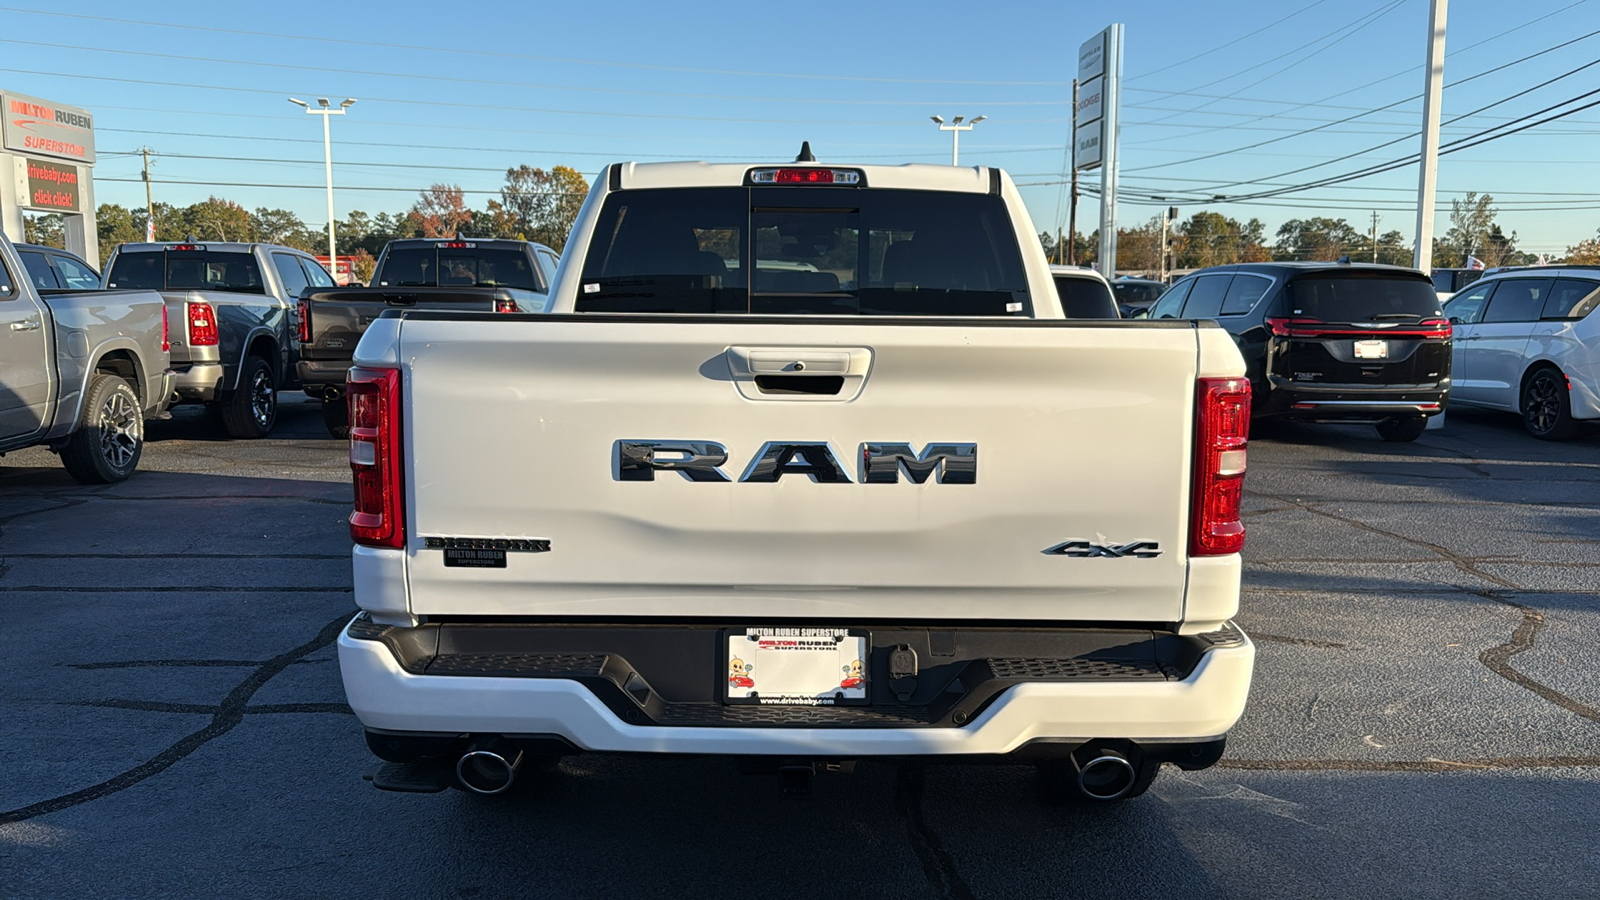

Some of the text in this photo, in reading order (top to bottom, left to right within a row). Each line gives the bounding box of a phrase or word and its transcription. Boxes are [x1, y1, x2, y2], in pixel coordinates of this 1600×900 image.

[10, 100, 91, 129] MILTON RUBEN
[24, 135, 86, 157] SUPERSTORE
[34, 189, 52, 205] click
[612, 439, 978, 484] RAM
[447, 550, 504, 559] MILTON RUBEN
[746, 628, 849, 637] MILTON RUBEN SUPERSTORE
